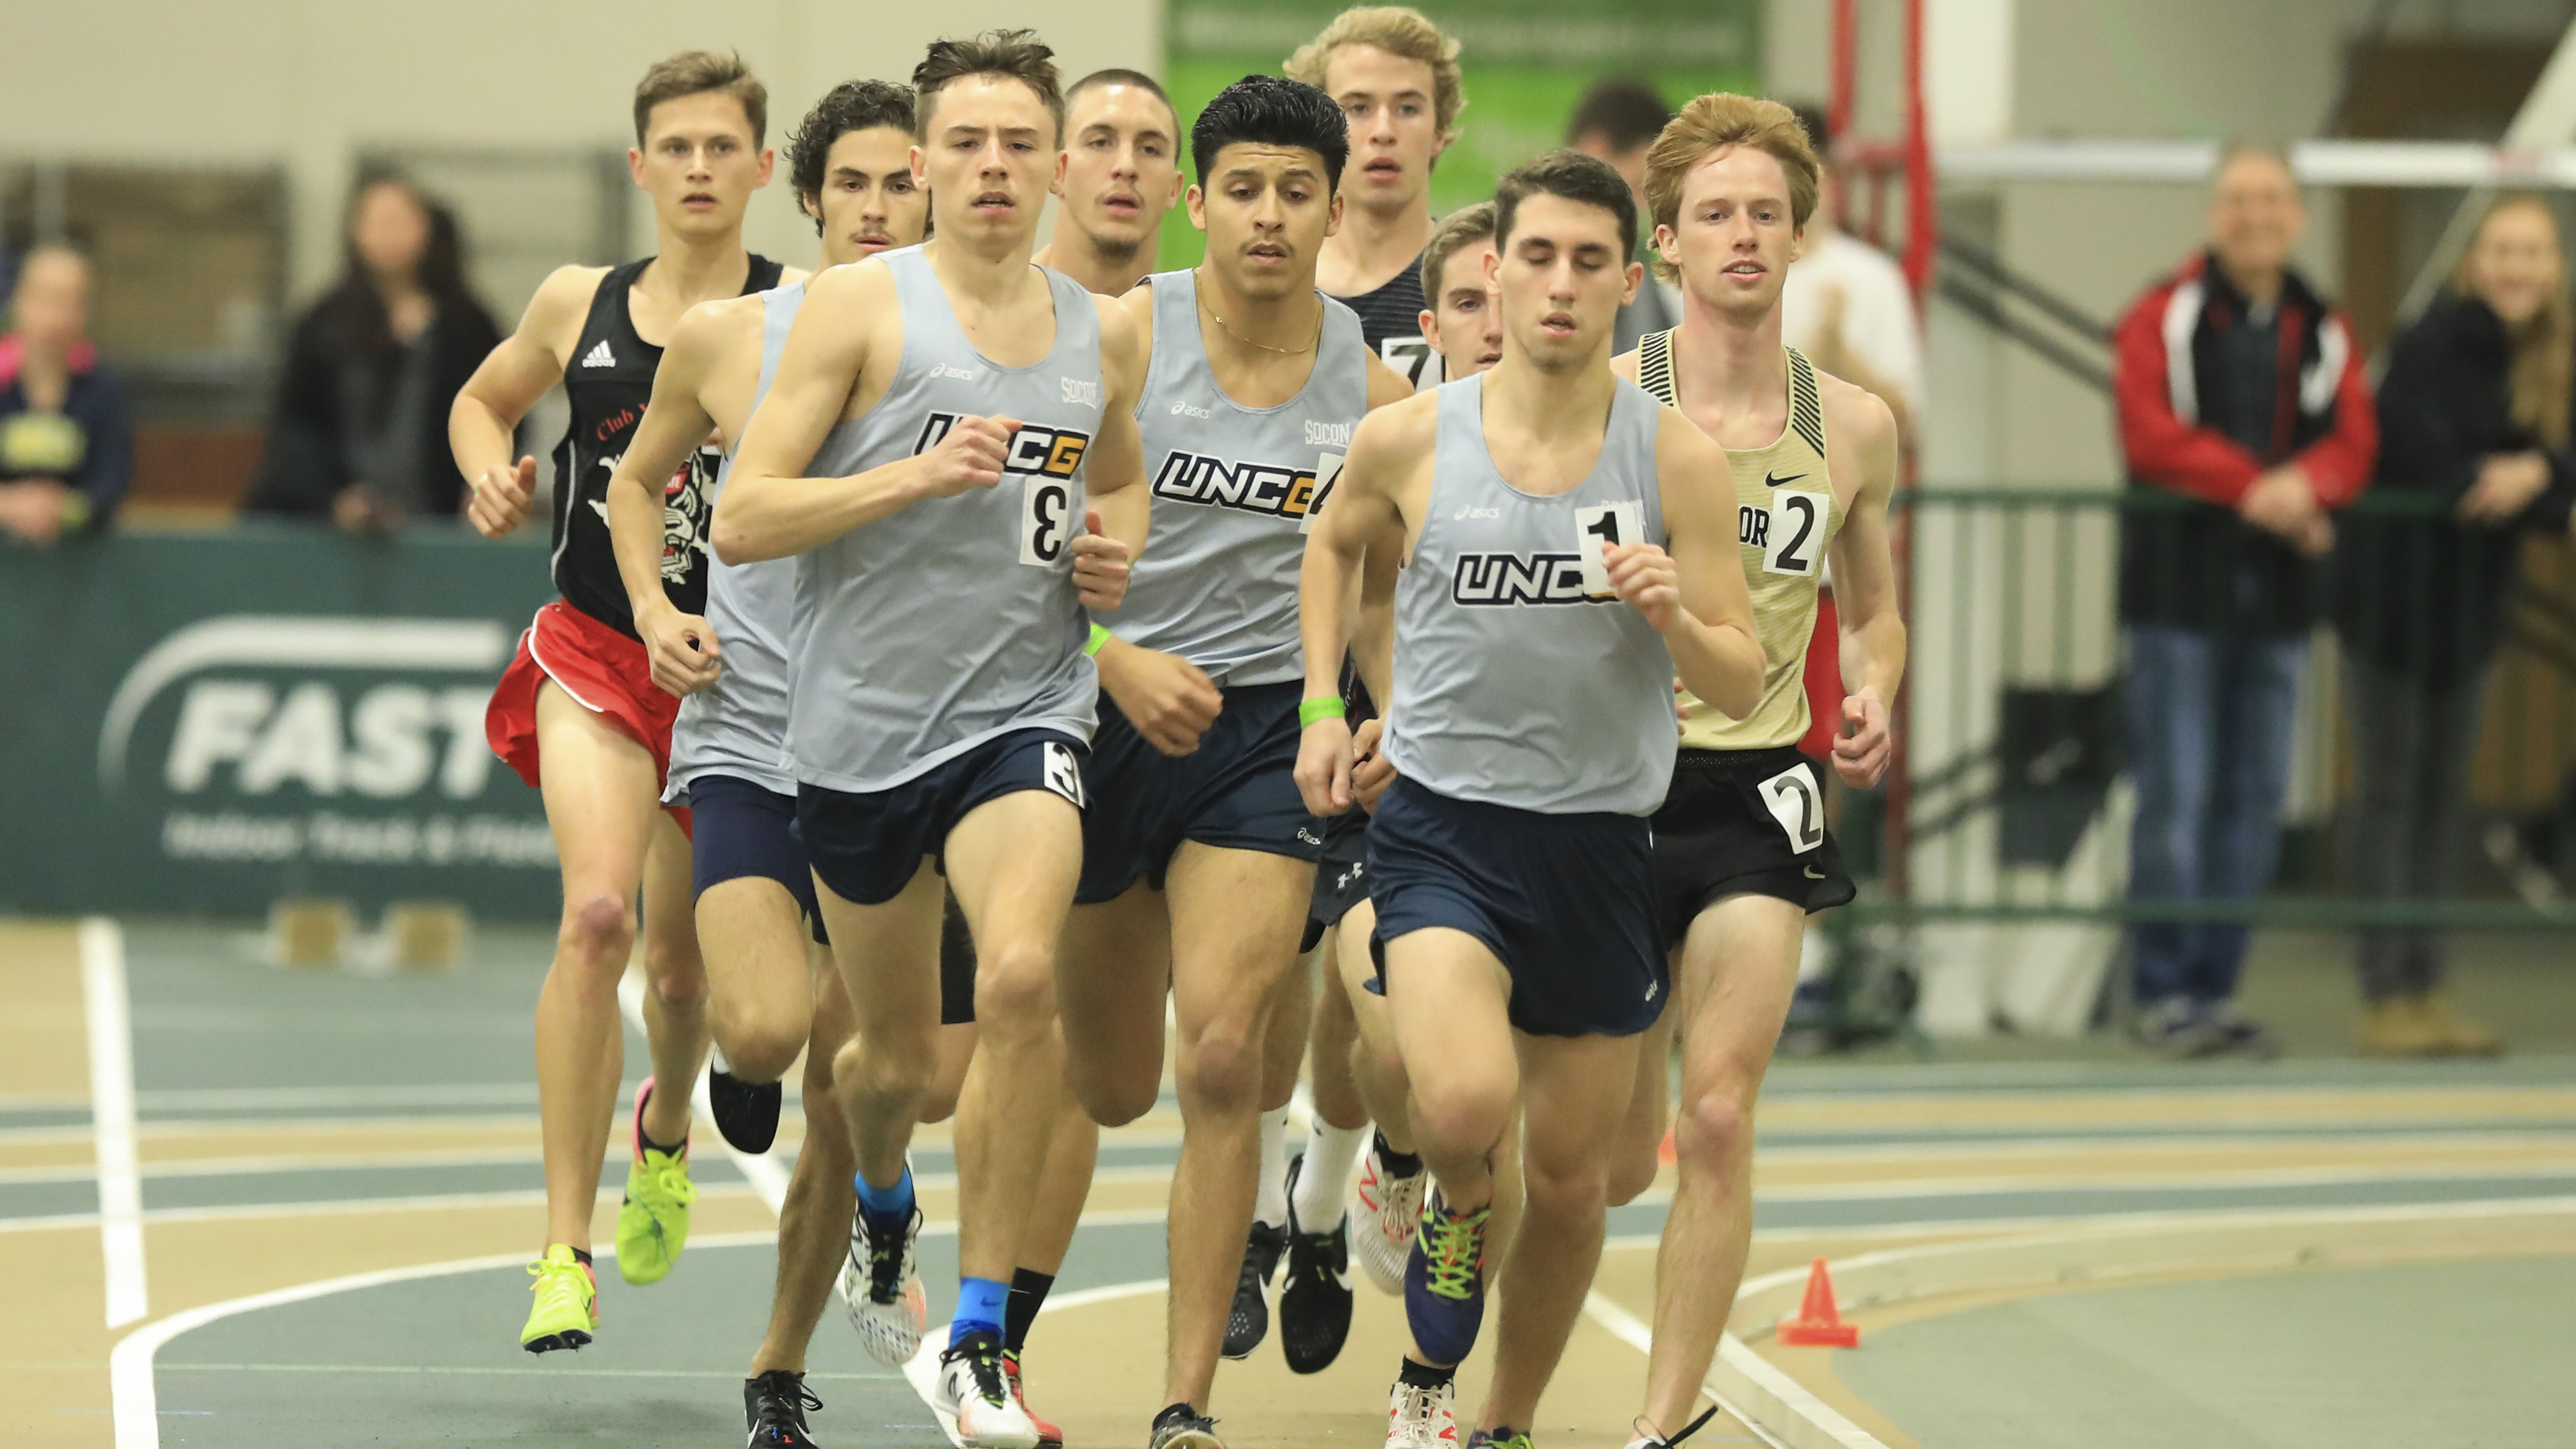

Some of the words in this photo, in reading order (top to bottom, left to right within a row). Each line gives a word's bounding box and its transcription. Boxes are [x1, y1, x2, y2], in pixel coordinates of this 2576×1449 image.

[944, 367, 972, 381] asics
[1390, 344, 1431, 390] 7
[1061, 376, 1097, 409] SOCON
[1184, 406, 1210, 419] asics
[596, 409, 634, 441] Club
[912, 410, 1091, 480] UCG
[1305, 418, 1350, 448] SOCON
[1469, 507, 1500, 519] asics
[1587, 511, 1620, 548] 1
[1775, 496, 1815, 571] 2
[1452, 551, 1623, 607] UNC
[165, 681, 496, 798] FAST
[1052, 743, 1080, 804] 3
[1773, 775, 1821, 846] 2
